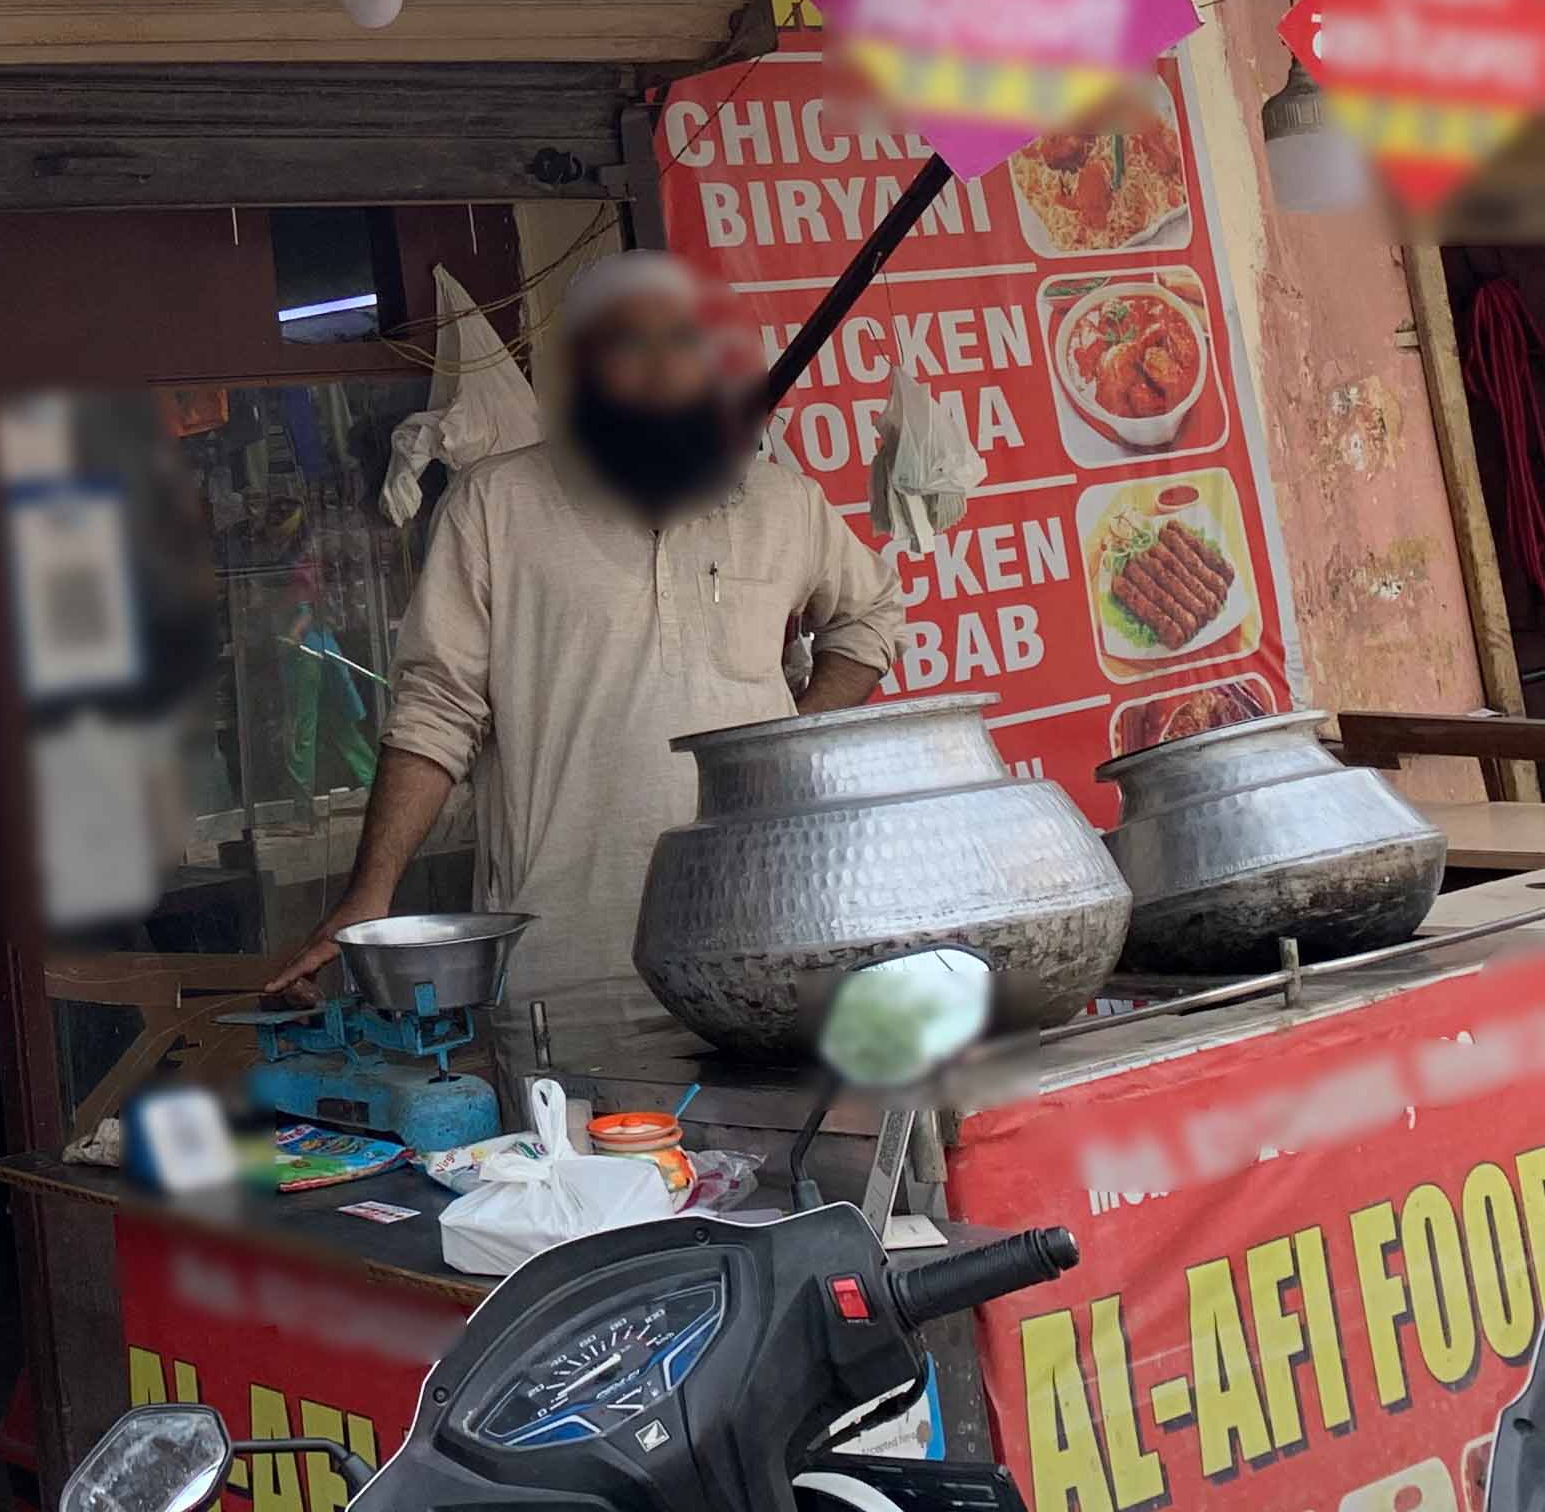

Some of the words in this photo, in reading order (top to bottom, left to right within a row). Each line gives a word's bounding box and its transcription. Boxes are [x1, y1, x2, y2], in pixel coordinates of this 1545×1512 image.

[760, 304, 1033, 389] HICKEN
[879, 516, 1071, 608] CKEN
[879, 604, 1045, 696] BAB
[1020, 1225, 1357, 1512] AL-AFI
[1349, 1146, 1545, 1414] FOO
